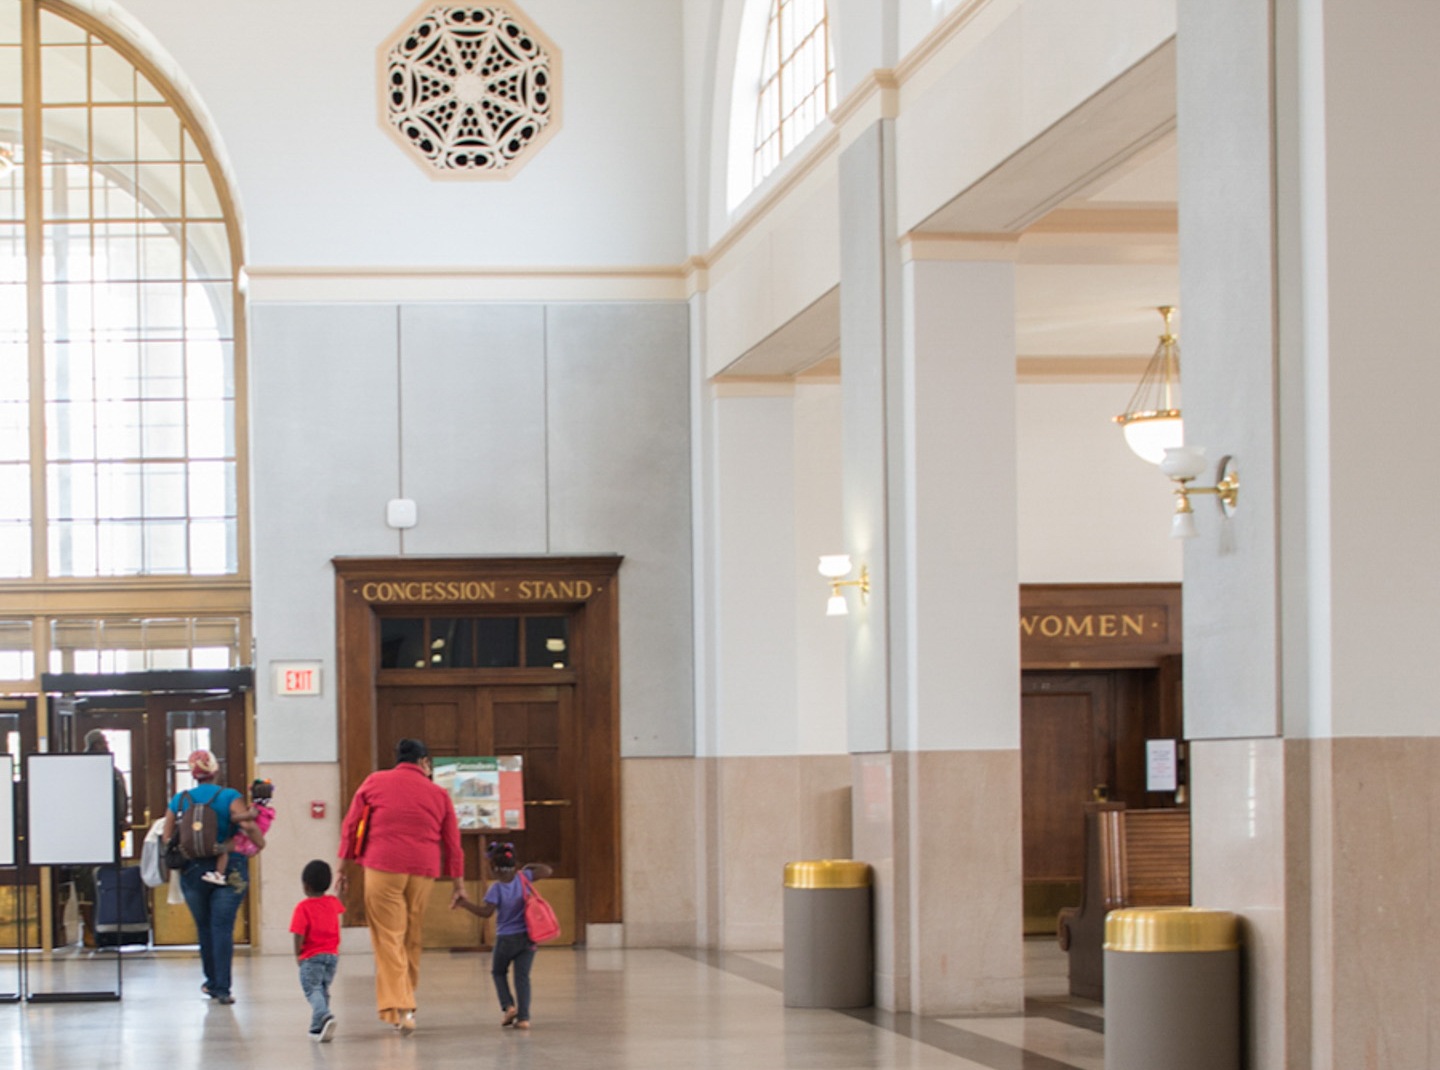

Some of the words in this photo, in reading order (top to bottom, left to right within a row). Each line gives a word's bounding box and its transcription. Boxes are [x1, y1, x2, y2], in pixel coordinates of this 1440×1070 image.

[362, 581, 496, 601] CONCESSION
[518, 580, 593, 599] STAND
[1020, 614, 1144, 637] WOMEN
[285, 670, 313, 691] EXIT
